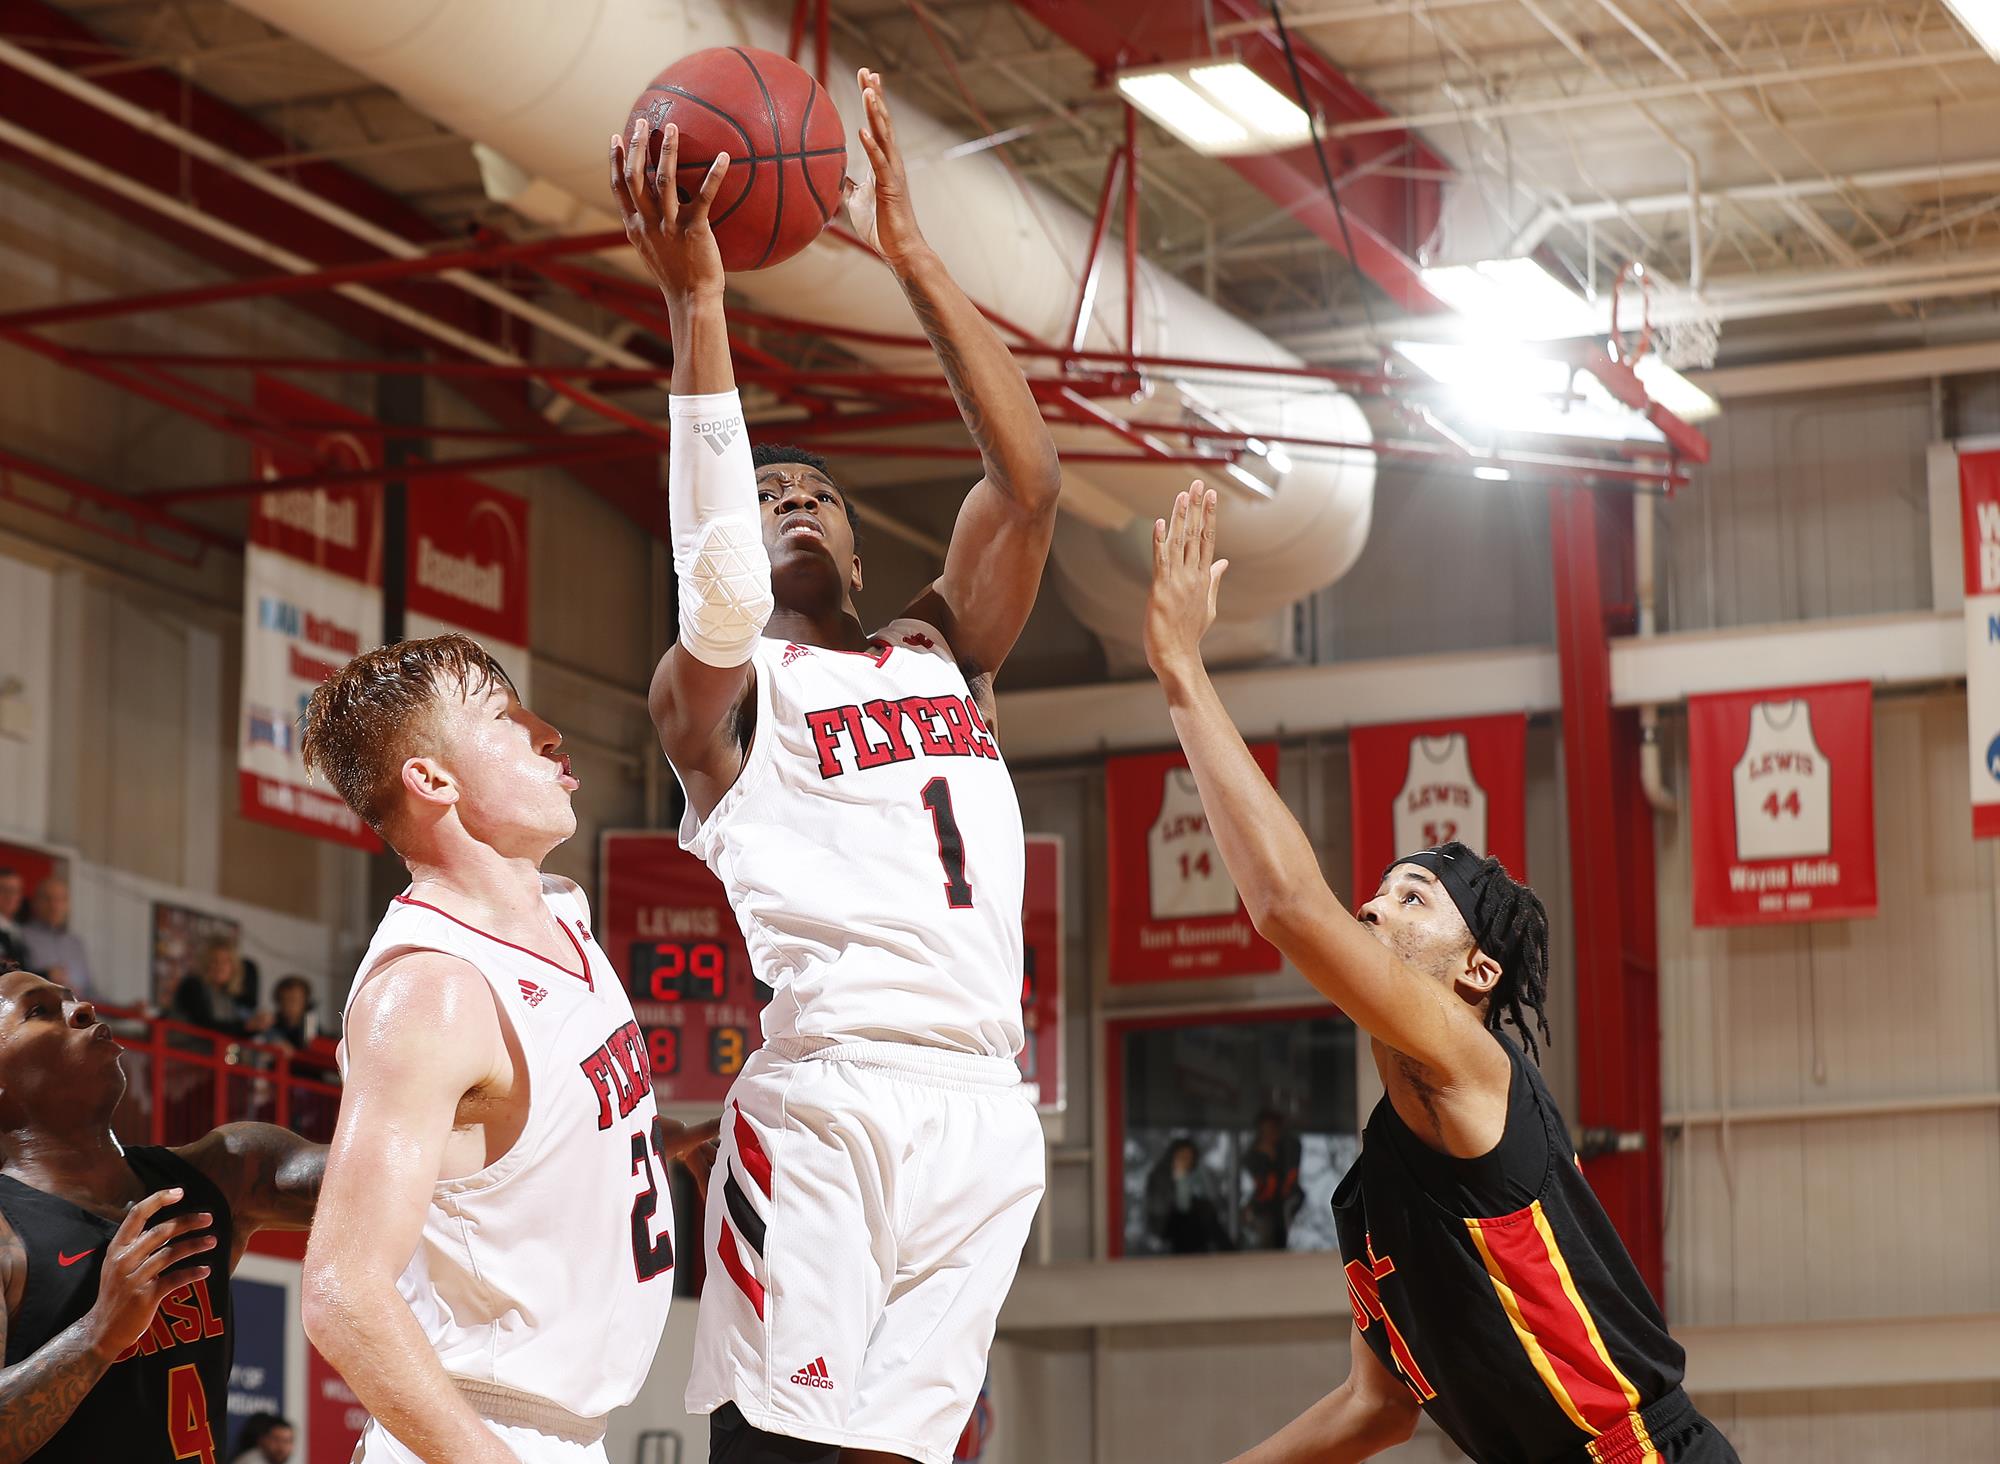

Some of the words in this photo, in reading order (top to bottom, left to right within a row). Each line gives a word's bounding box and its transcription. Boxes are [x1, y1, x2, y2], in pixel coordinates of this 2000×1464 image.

[693, 416, 740, 434] adidas
[1749, 752, 1813, 780] LEWIS
[1407, 784, 1471, 814] LEWIS
[1762, 789, 1801, 820] 44
[920, 776, 975, 909] 1
[1162, 815, 1210, 844] LEW
[1178, 850, 1213, 880] 14
[637, 906, 718, 936] LEWIS
[650, 943, 725, 1001] 29
[648, 1028, 677, 1074] 8
[718, 1028, 744, 1075] 3
[790, 1374, 834, 1390] adidas
[167, 1363, 216, 1464] 4
